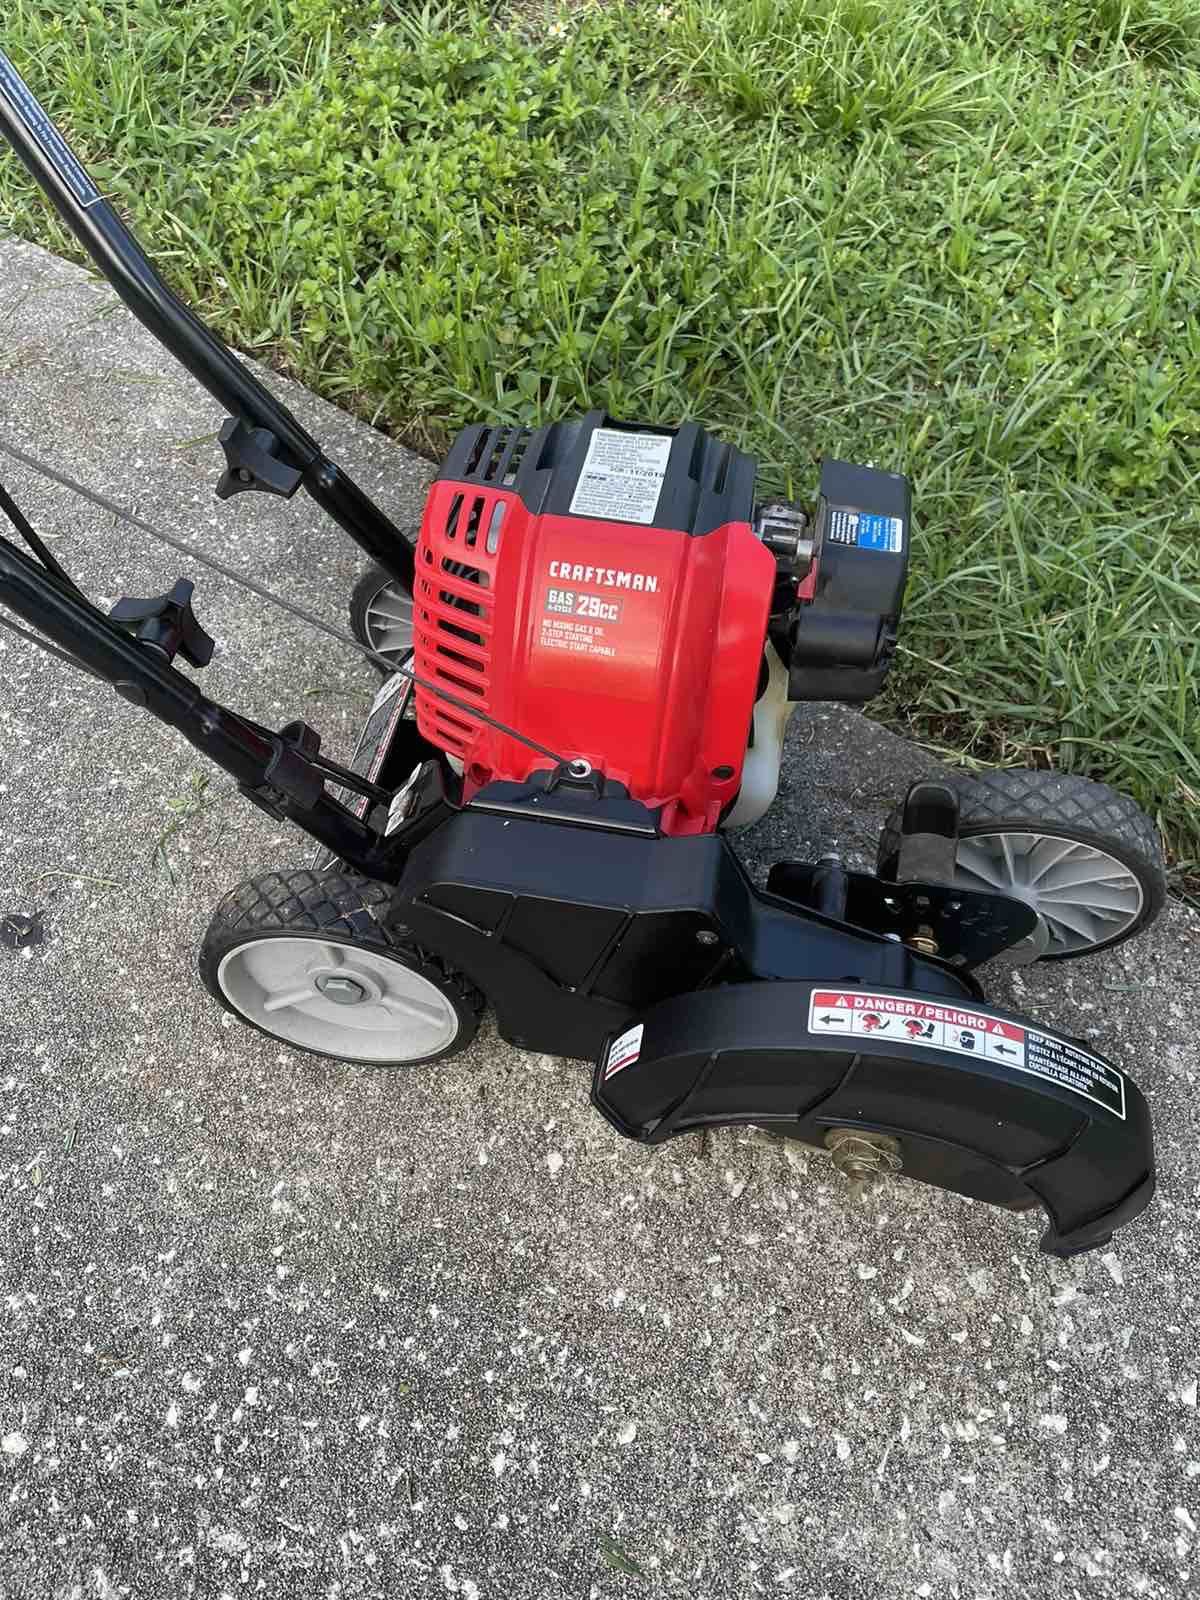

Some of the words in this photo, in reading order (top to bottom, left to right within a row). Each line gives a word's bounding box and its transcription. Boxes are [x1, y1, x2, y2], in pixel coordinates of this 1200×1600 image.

[549, 560, 658, 593] CRAFTSMAN
[548, 589, 574, 606] GAS
[543, 619, 553, 628] NO
[542, 628, 564, 638] 2-STEP
[565, 631, 593, 644] STARTING
[569, 641, 588, 652] START
[1028, 1033, 1044, 1044] KEEP
[1028, 1043, 1050, 1057] RESTEZ
[1028, 1060, 1059, 1078] CUCHILLA
